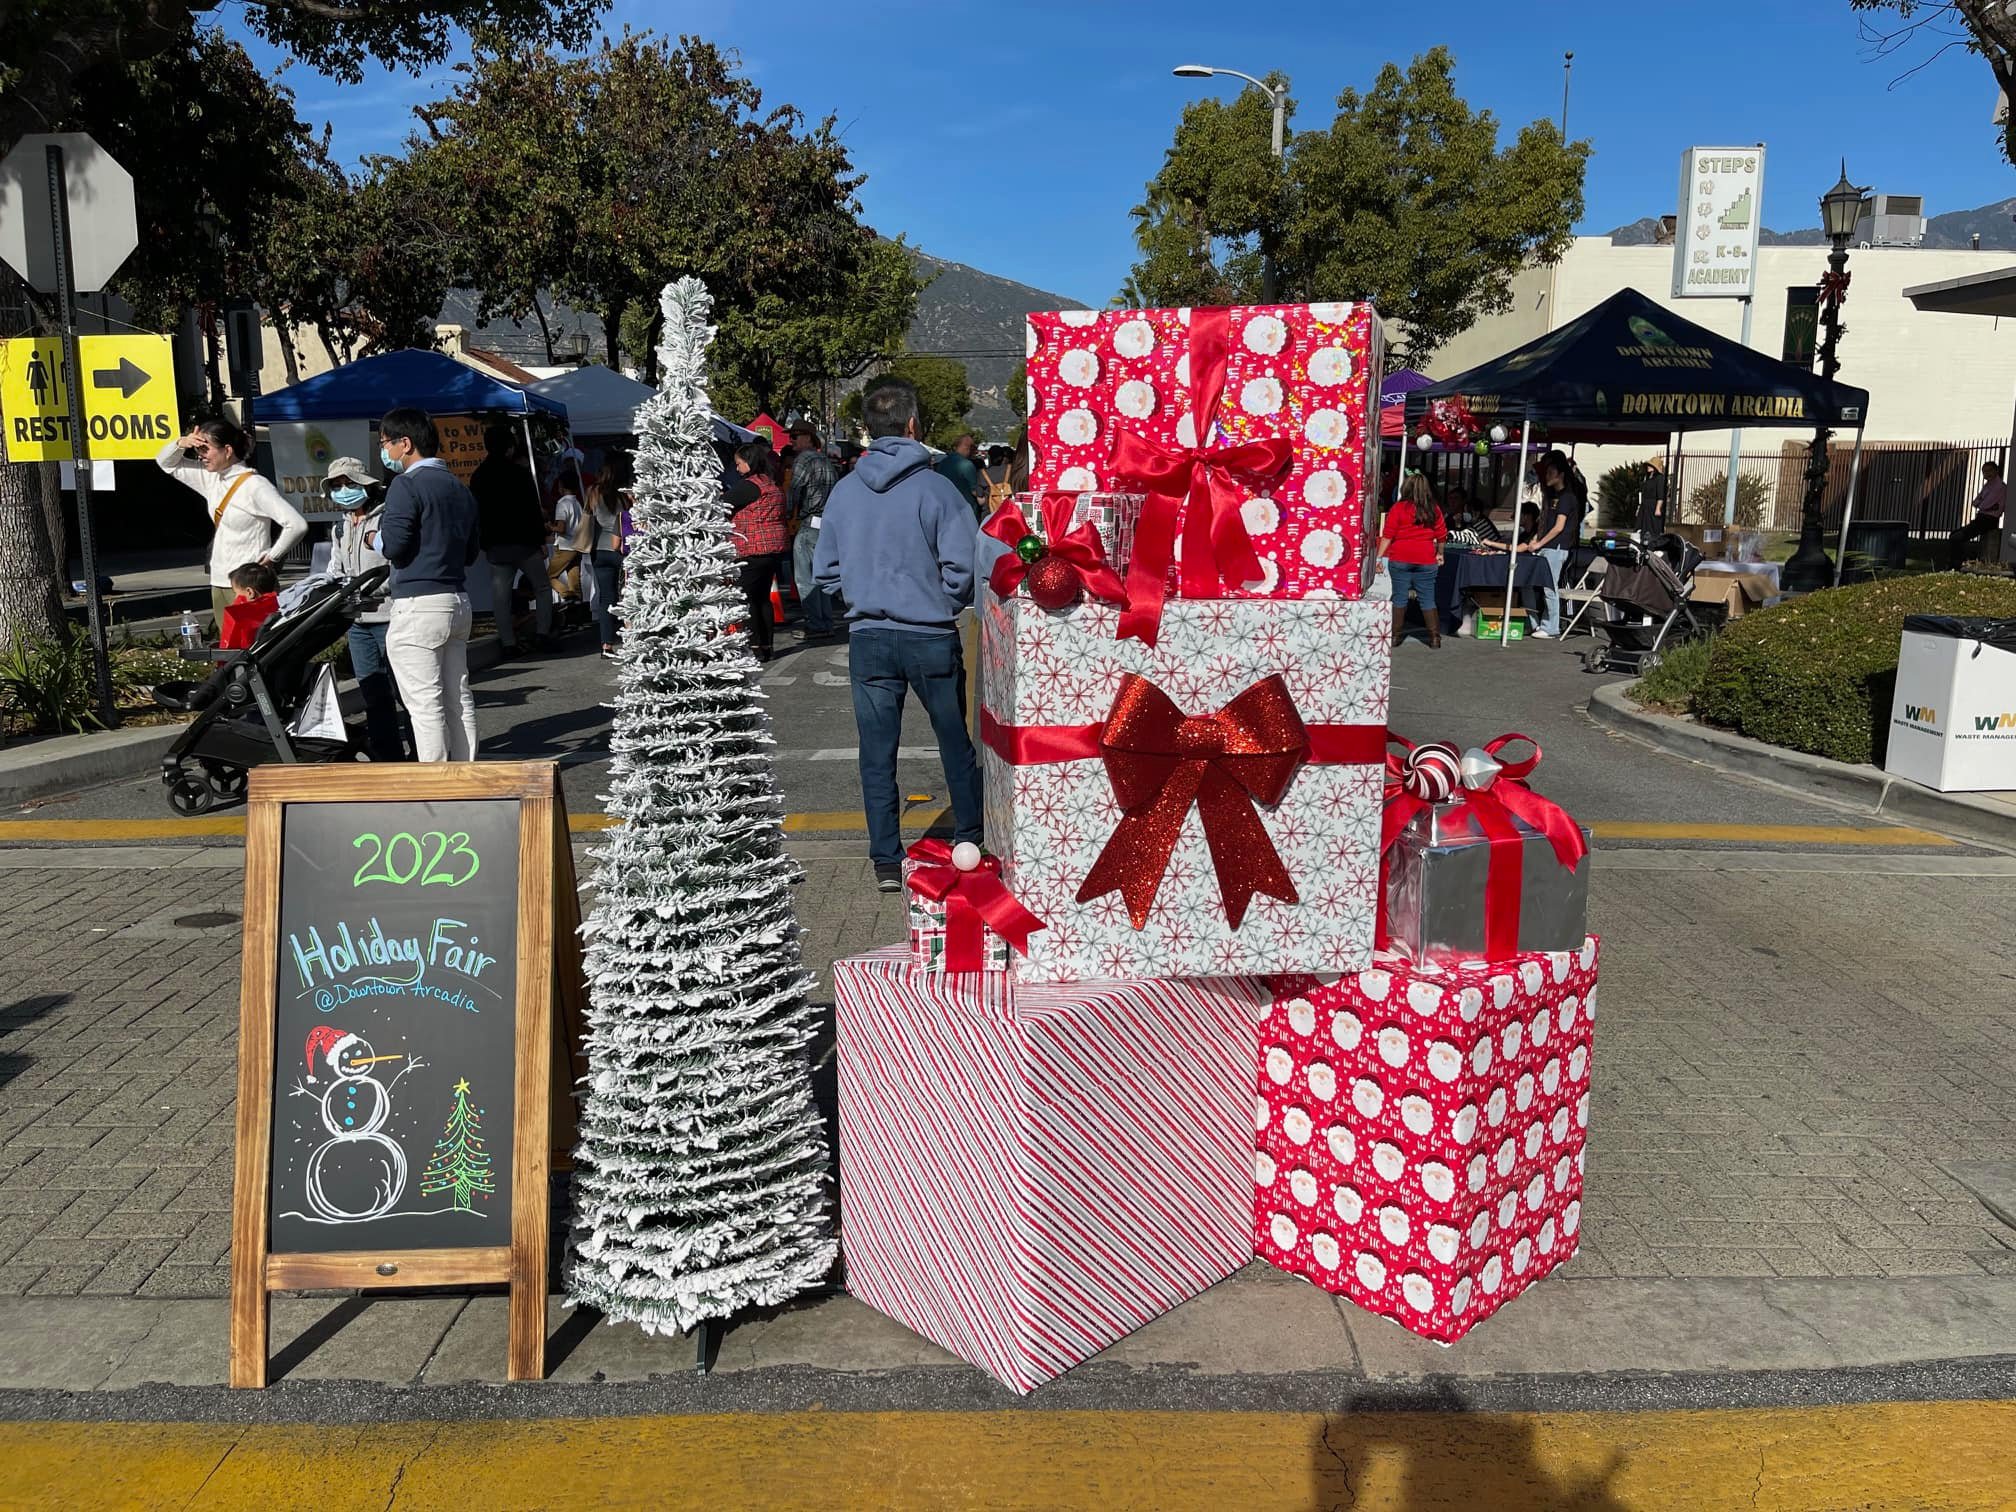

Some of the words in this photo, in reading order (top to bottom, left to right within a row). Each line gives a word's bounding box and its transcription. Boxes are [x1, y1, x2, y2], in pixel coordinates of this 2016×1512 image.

[1698, 157, 1756, 173] STEPS
[1687, 268, 1750, 284] ACADEMY
[1615, 345, 1713, 359] DOWNTOWN
[1621, 393, 1726, 414] DOWNTOWN
[1731, 395, 1805, 418] ARCADIA
[14, 414, 172, 442] RESTOOMS
[1905, 704, 1936, 725] WM
[1909, 722, 1944, 738] MANAGEMENT
[352, 831, 480, 888] 2023
[289, 917, 426, 987] Holiday
[427, 918, 497, 977] Fair
[410, 979, 480, 1013] Arcadia
